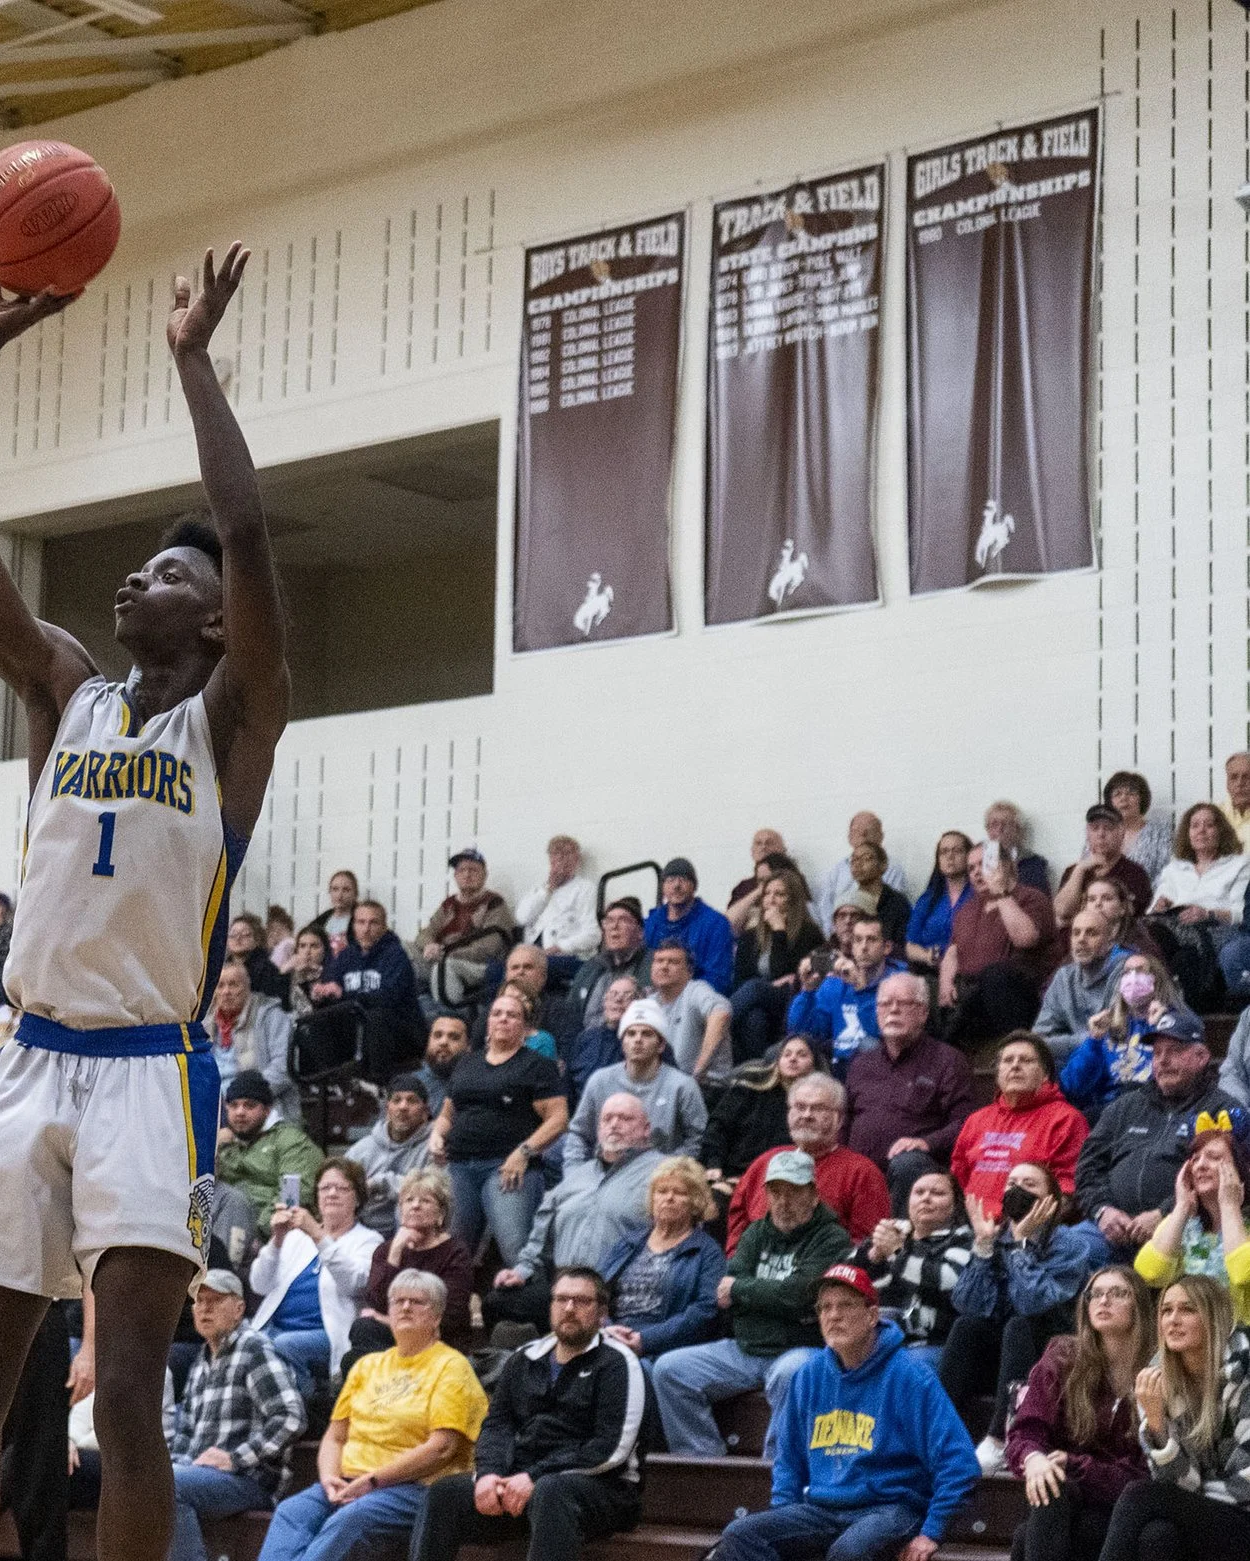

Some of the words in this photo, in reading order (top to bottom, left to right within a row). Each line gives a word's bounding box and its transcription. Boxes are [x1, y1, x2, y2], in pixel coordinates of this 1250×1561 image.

[915, 152, 962, 199] GIRLS
[963, 135, 1019, 176] TRACK
[1022, 133, 1038, 160] &
[1041, 119, 1090, 157] FIELD
[719, 196, 786, 245] TRACK
[794, 191, 814, 214] &
[817, 174, 880, 213] FIELD
[530, 250, 566, 291] BOYS
[566, 237, 617, 272] TRACK
[618, 232, 633, 257] &
[635, 221, 679, 256] FIELD
[50, 749, 196, 817] WARRIORS
[92, 811, 116, 879] 1
